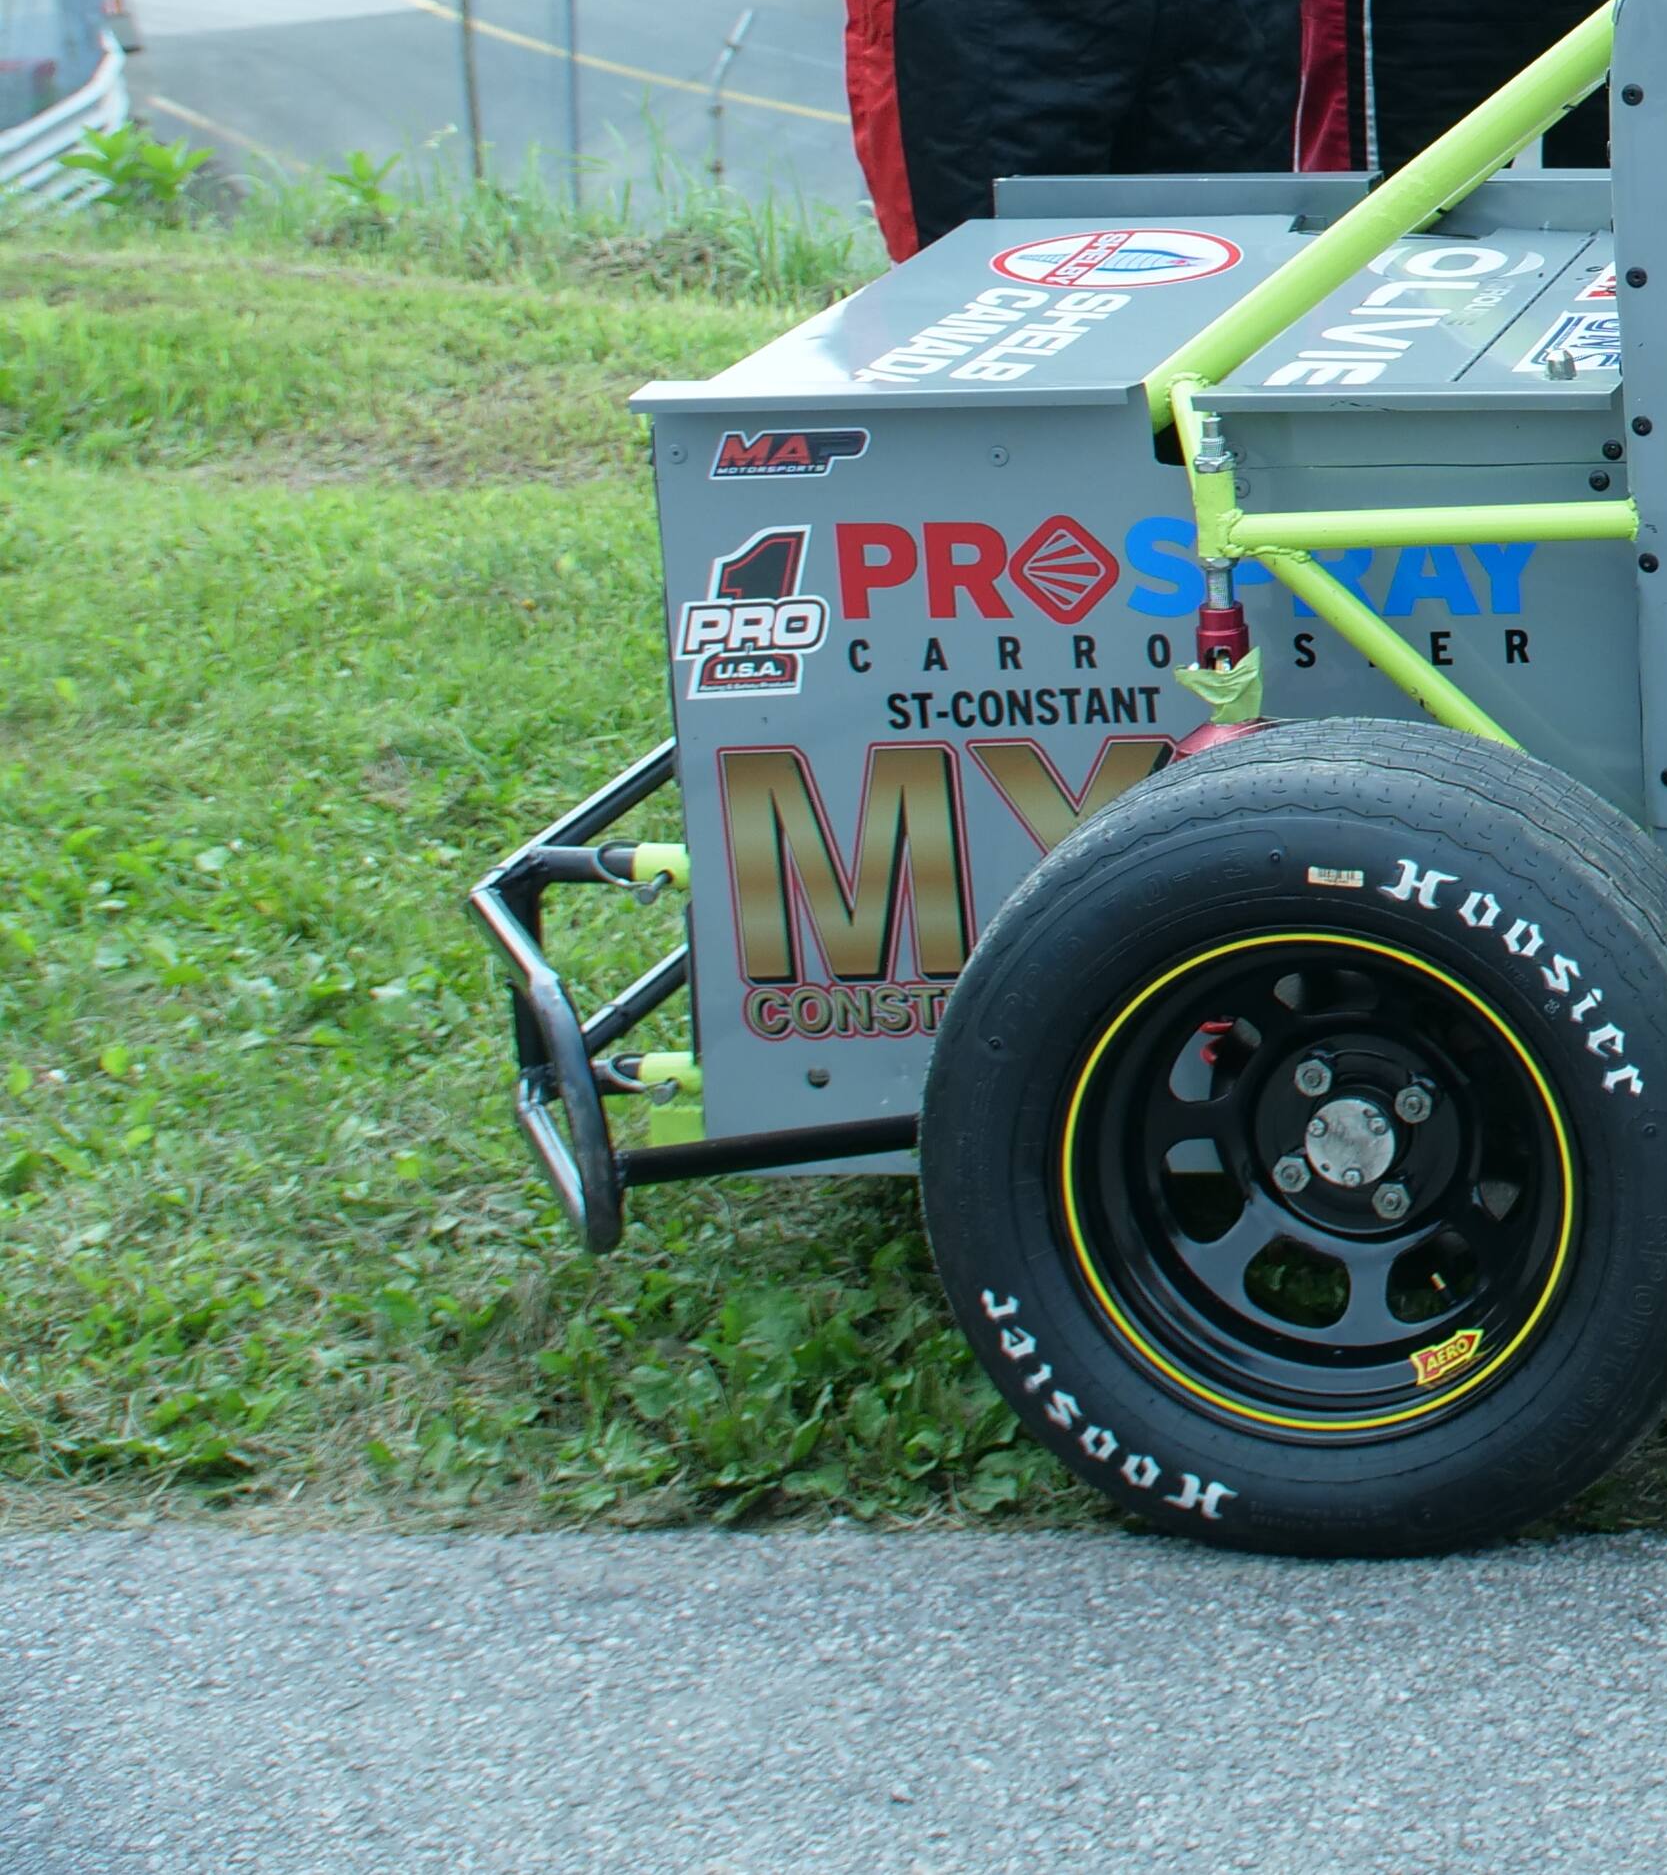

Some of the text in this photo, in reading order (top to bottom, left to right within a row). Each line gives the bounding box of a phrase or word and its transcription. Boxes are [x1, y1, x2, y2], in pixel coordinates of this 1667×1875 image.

[949, 291, 1131, 382] SHELB
[1263, 246, 1511, 386] OLIVIE
[716, 464, 826, 476] MOTORSPORTS
[718, 430, 866, 467] MAP
[680, 599, 828, 655] PRO
[714, 660, 783, 680] U.S.A.
[888, 687, 1160, 730] ST-CONSTANT
[1380, 858, 1645, 1099] Hoosier
[1425, 1338, 1470, 1372] AERO
[978, 1287, 1238, 1522] Hoosier
